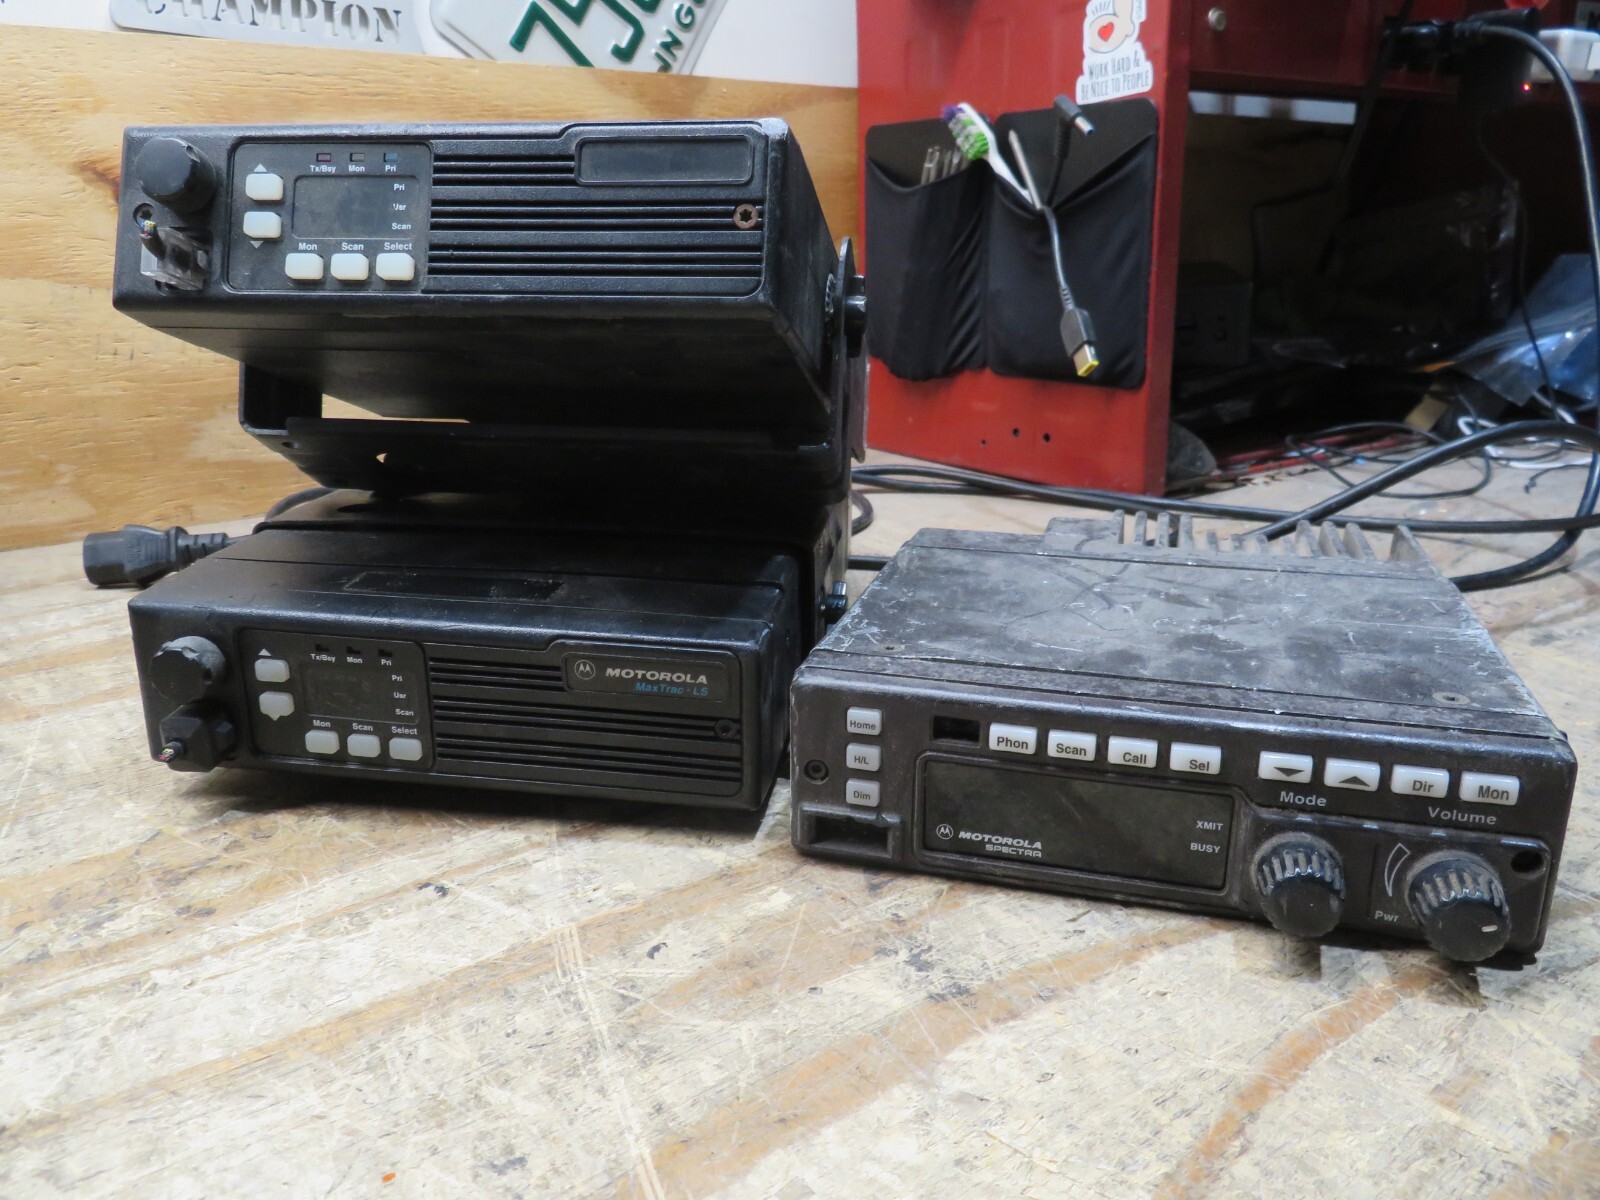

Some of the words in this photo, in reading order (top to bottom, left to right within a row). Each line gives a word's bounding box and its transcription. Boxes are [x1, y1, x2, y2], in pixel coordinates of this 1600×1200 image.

[1123, 70, 1149, 91] PEOPLE
[394, 183, 405, 191] Pri
[392, 222, 411, 230] Scan
[298, 242, 317, 251] Mon
[341, 242, 364, 251] Scan
[384, 242, 412, 251] Select
[346, 656, 363, 664] Mon
[605, 667, 708, 685] MOTOROLA
[395, 709, 414, 717] Scan
[313, 720, 331, 728] Mon
[352, 723, 373, 731] Scan
[849, 719, 876, 731] Home
[391, 726, 418, 735] Select
[996, 736, 1029, 751] Phon
[1056, 742, 1087, 757] Scan
[853, 754, 870, 765] H/L
[1122, 751, 1147, 765] Call
[1188, 758, 1210, 771] Sel
[1412, 780, 1434, 794] Dir
[1478, 785, 1510, 801] Mon
[853, 790, 871, 800] Dim
[1280, 791, 1327, 807] Mode
[1428, 806, 1497, 825] Volume
[1196, 820, 1223, 831] XMIT
[958, 832, 1042, 849] MOTOROLA
[985, 844, 1042, 858] SPECTRA
[1190, 842, 1220, 854] BUSY
[1374, 910, 1400, 923] Pwr
